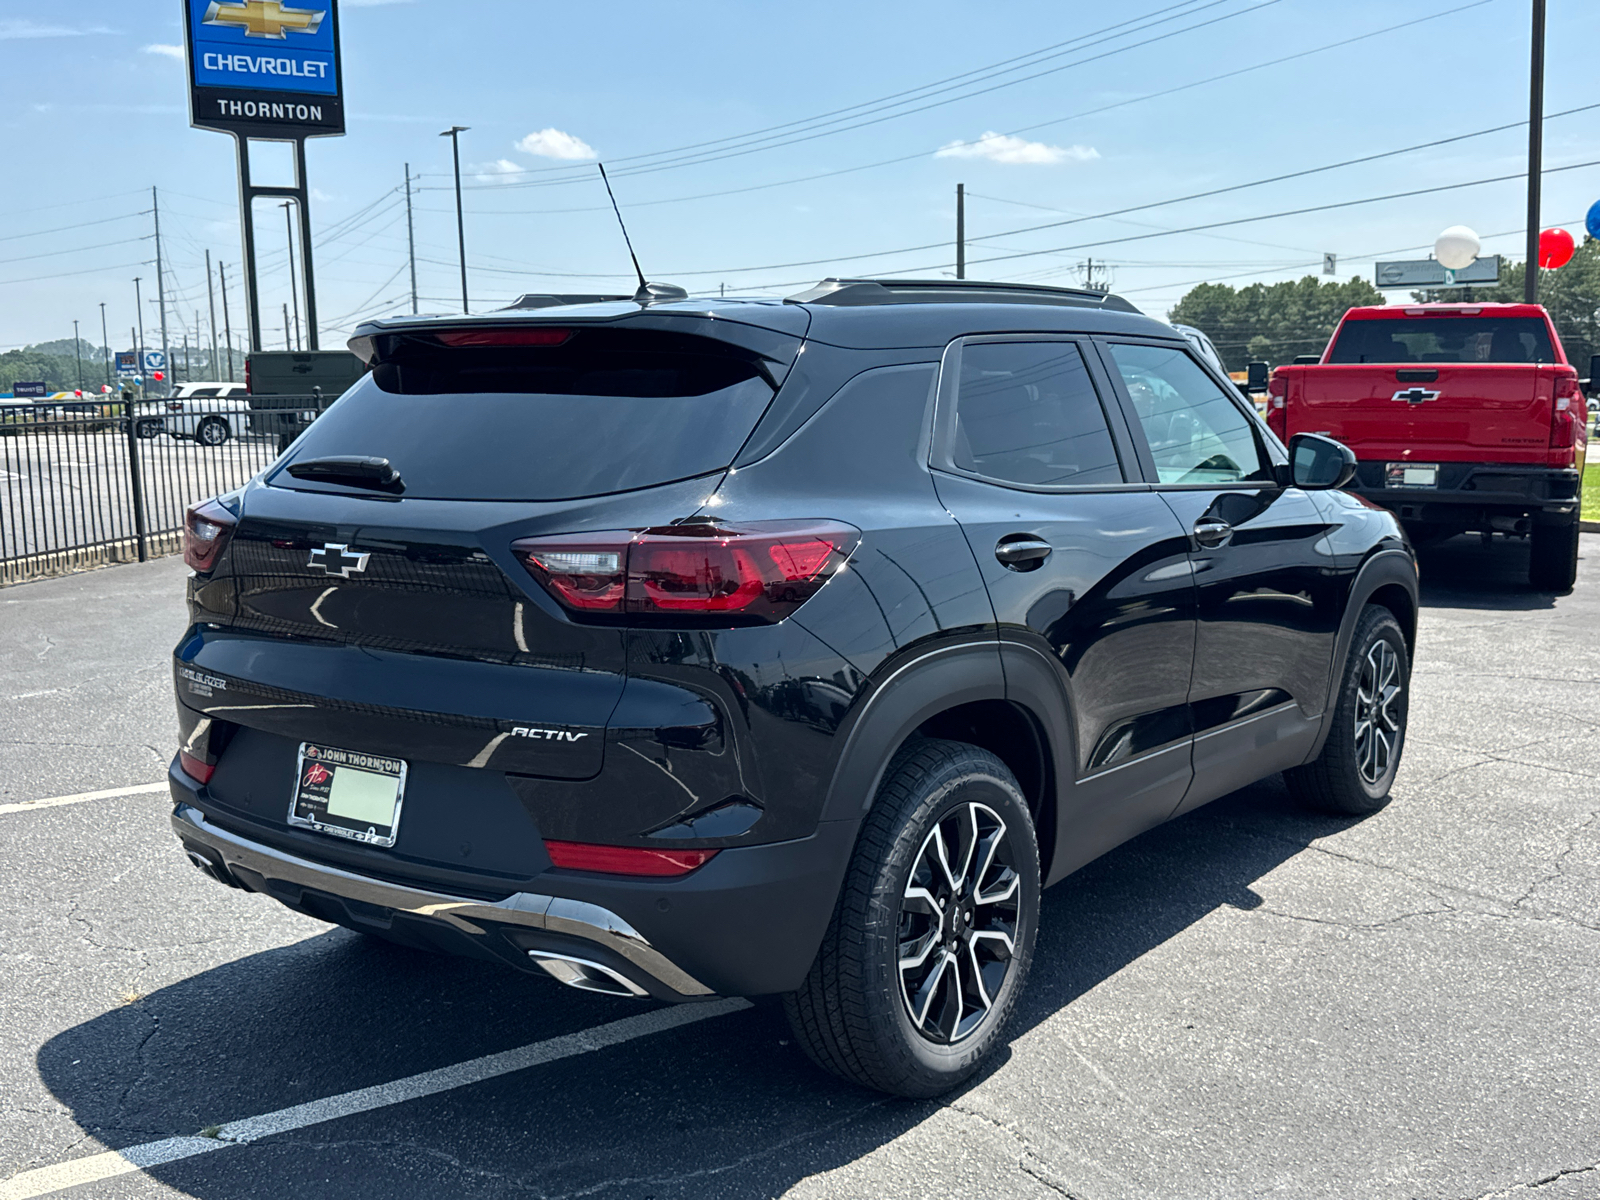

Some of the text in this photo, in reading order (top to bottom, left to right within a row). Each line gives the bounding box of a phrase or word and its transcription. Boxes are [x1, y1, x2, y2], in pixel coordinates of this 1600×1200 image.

[203, 52, 329, 79] CHEVROLET
[217, 99, 322, 121] THORNTON
[510, 726, 589, 742] ACTIV
[322, 748, 400, 773] JOHN THORNTON
